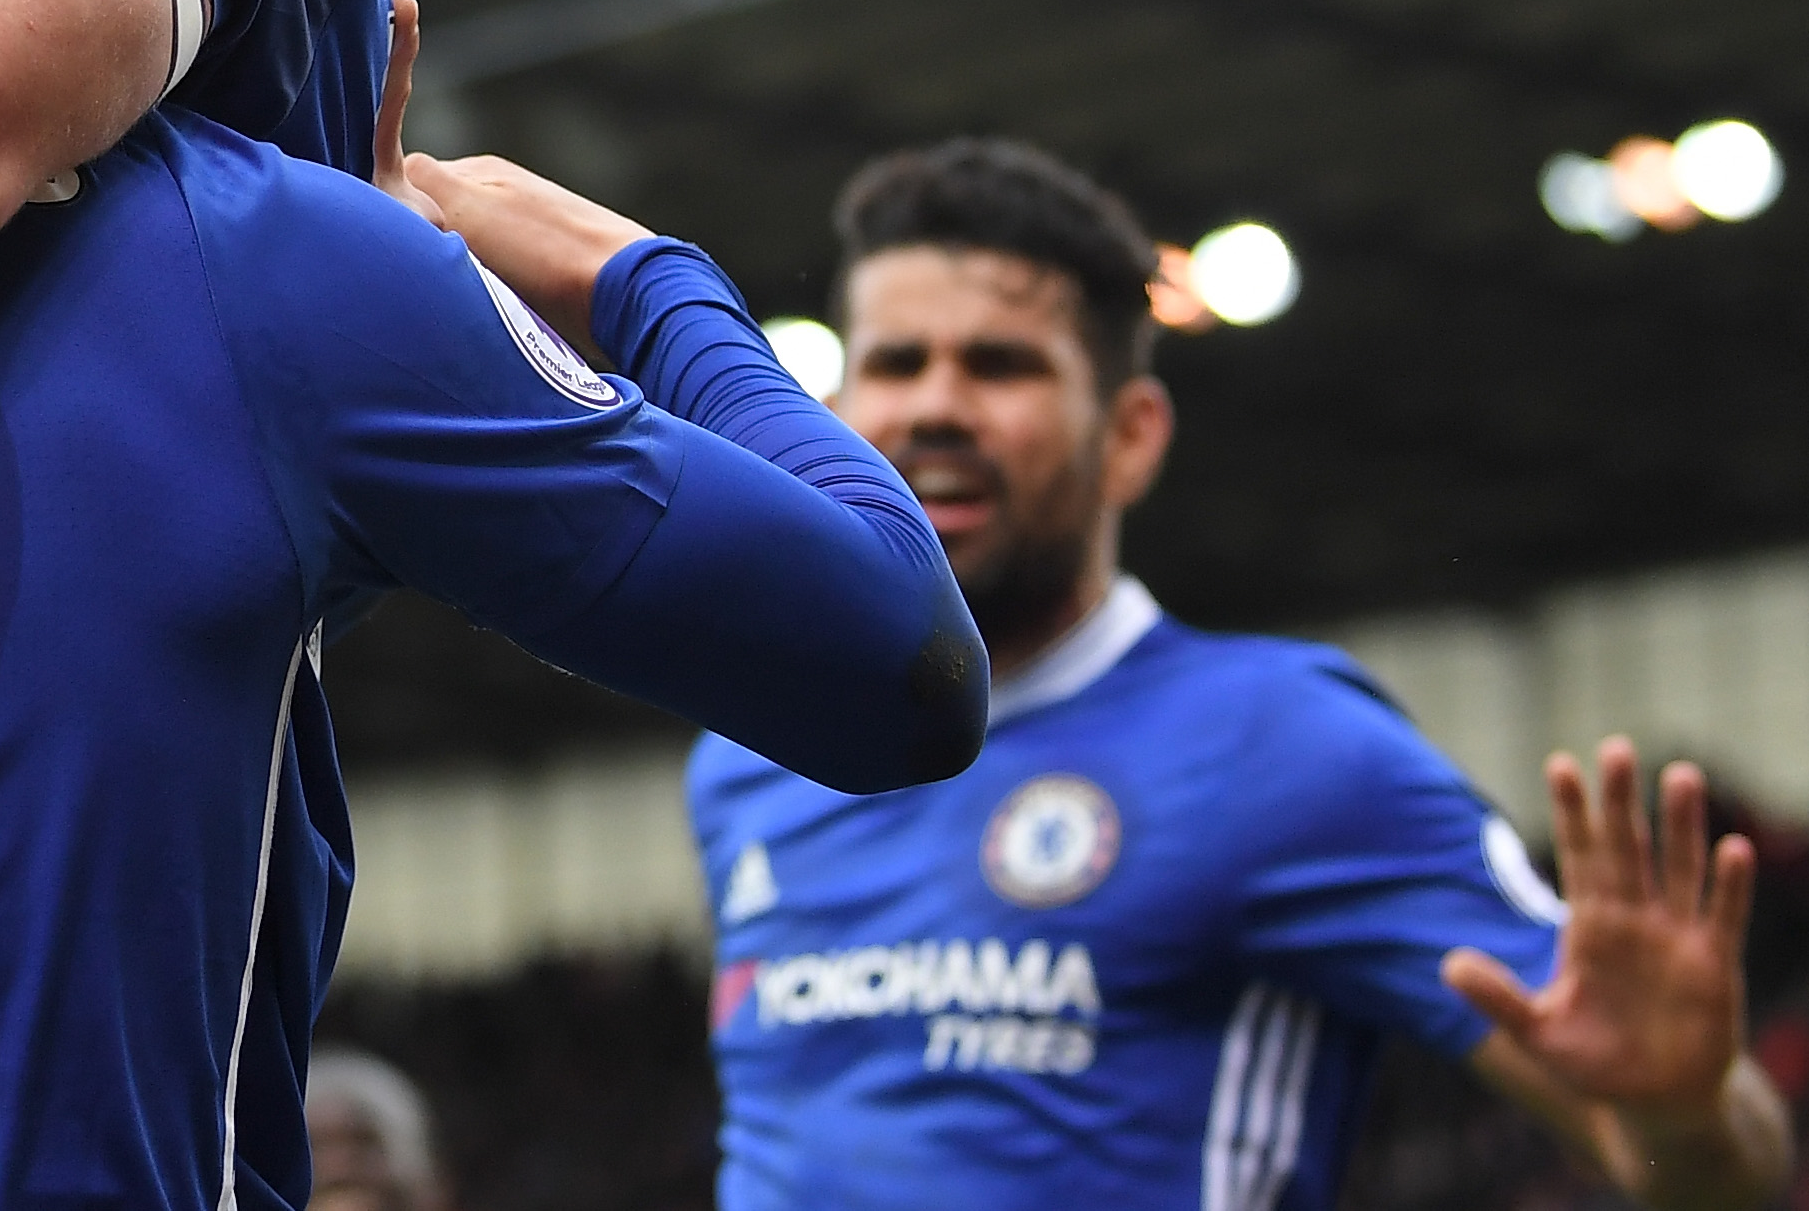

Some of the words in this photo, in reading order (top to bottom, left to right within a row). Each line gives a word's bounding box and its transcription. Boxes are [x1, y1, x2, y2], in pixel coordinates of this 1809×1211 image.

[526, 331, 572, 382] Premier
[756, 937, 1102, 1031] YOKOHAMA
[923, 1013, 1096, 1076] TYRES
